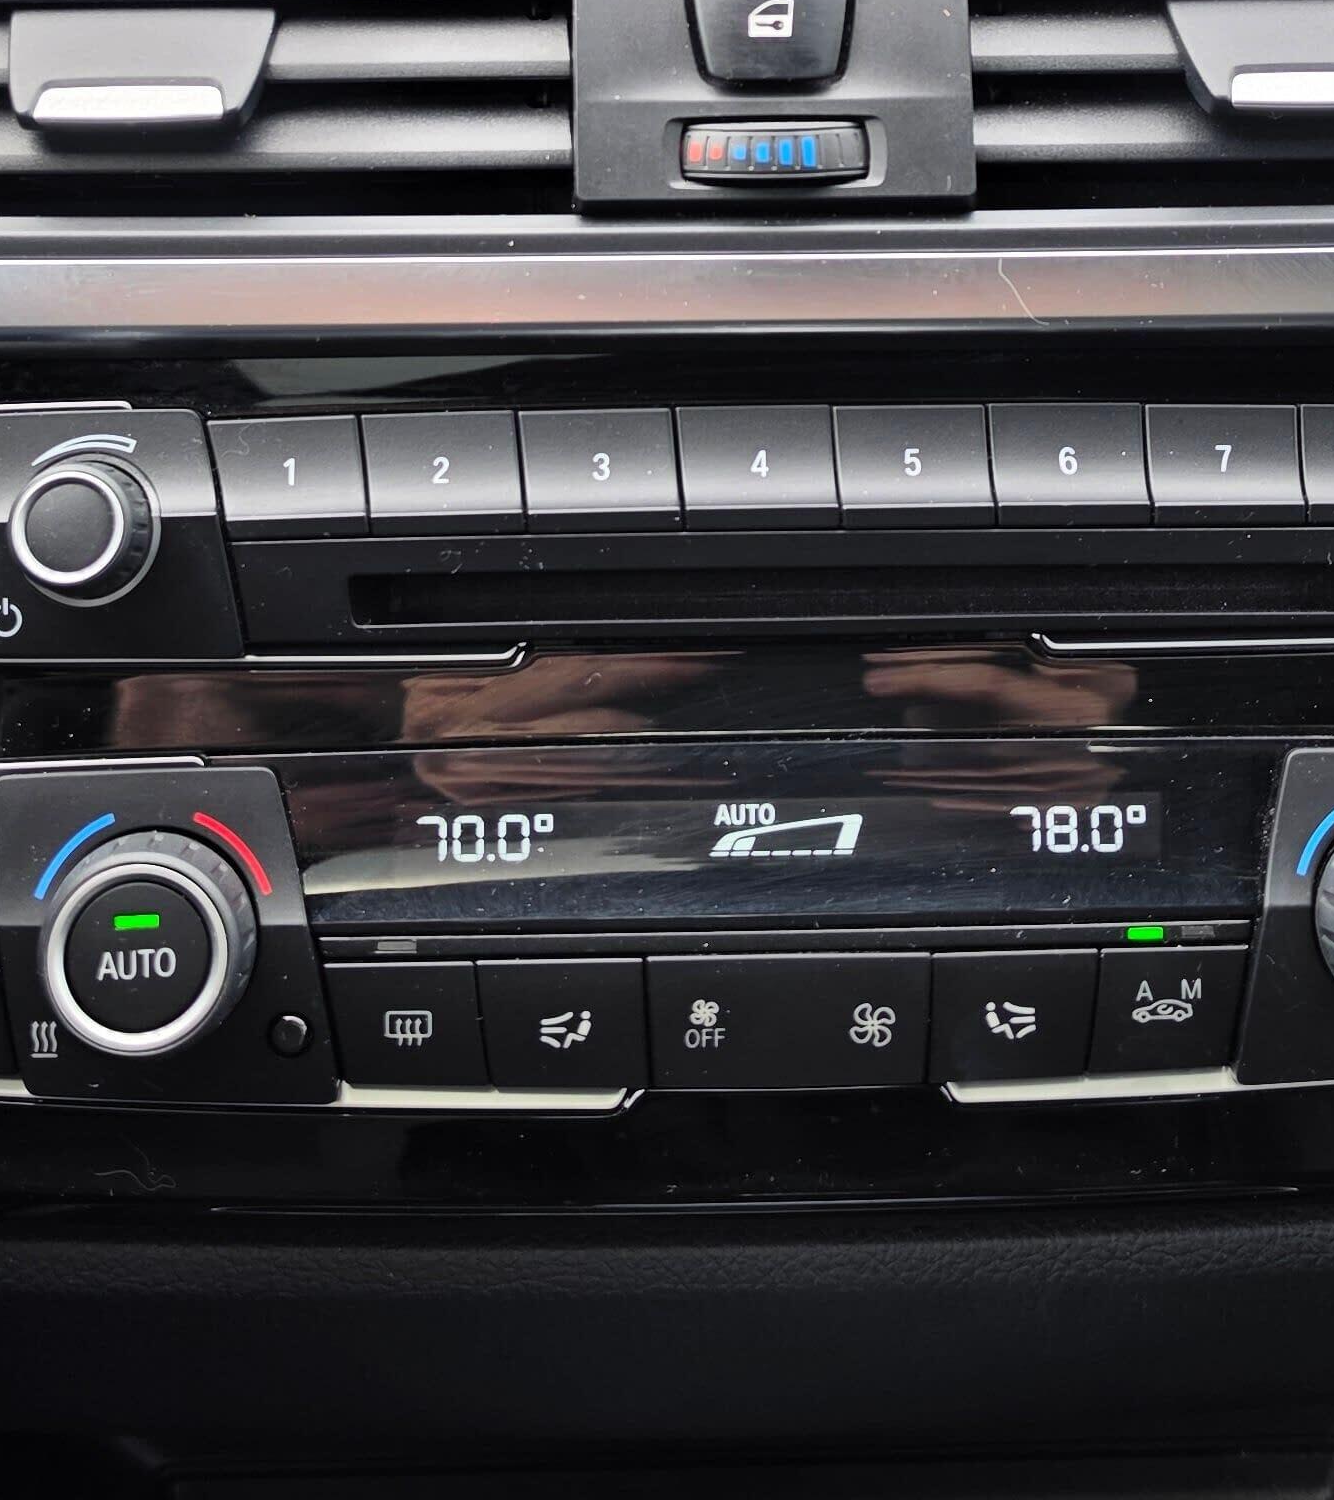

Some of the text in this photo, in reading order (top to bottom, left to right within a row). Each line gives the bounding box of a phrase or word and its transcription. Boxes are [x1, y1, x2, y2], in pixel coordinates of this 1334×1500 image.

[282, 457, 297, 486] 1
[431, 456, 451, 485] 2
[591, 453, 611, 482] 3
[750, 450, 769, 478] 4
[903, 448, 923, 477] 5
[1057, 446, 1079, 476] 6
[1214, 444, 1233, 473] 7
[713, 803, 777, 827] AUTO
[1009, 803, 1148, 855] 78.0°
[416, 813, 555, 862] 70.0°
[96, 946, 177, 981] AUTO
[1136, 978, 1203, 1001] A M
[683, 1027, 727, 1050] OFF
